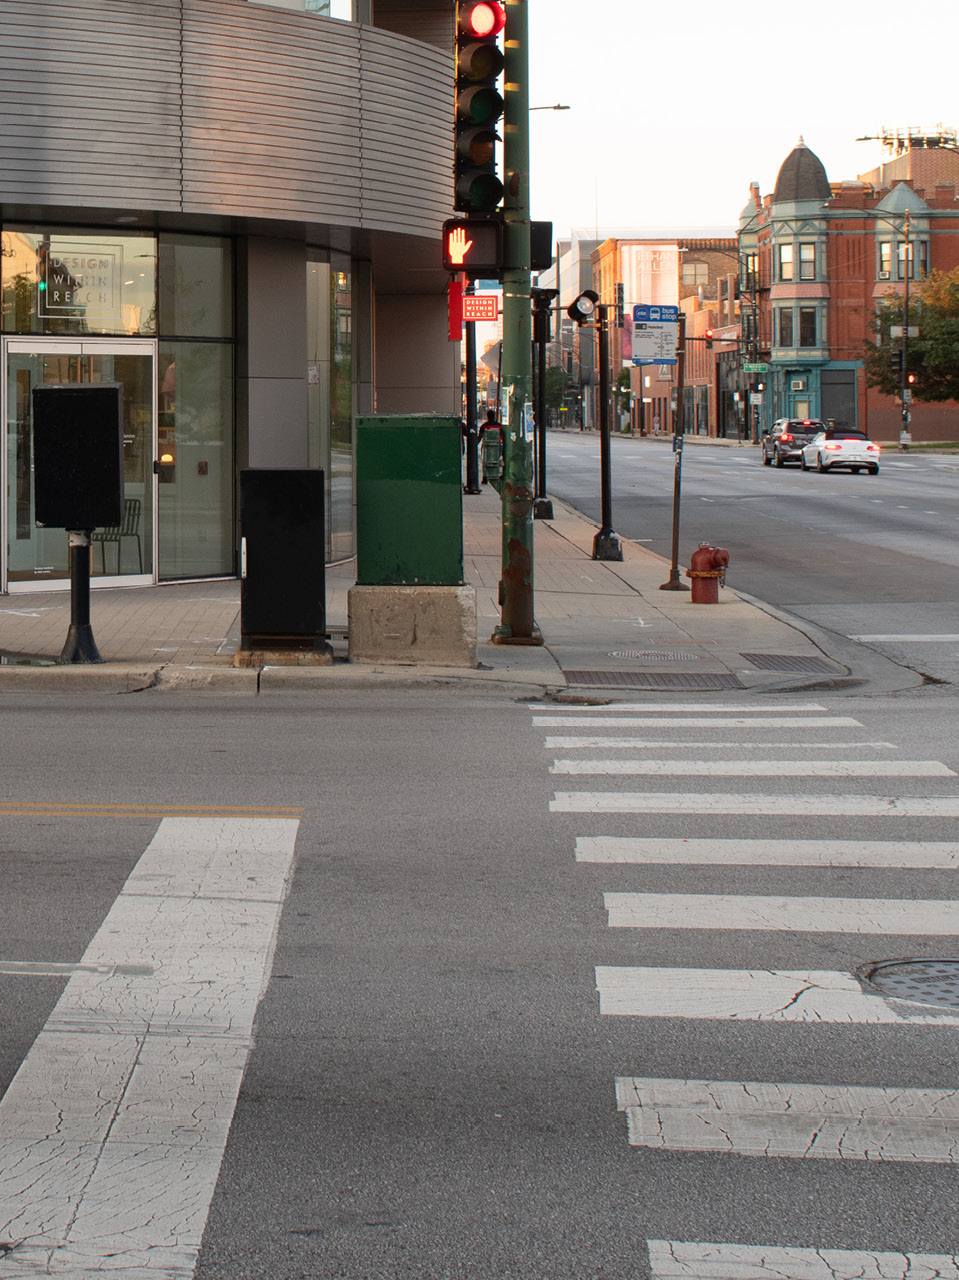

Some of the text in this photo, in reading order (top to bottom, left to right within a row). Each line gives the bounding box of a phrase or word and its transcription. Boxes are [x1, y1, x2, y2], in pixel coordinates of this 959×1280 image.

[637, 251, 675, 261] ETHAN
[53, 256, 109, 269] DESIGN
[53, 290, 107, 302] REACH
